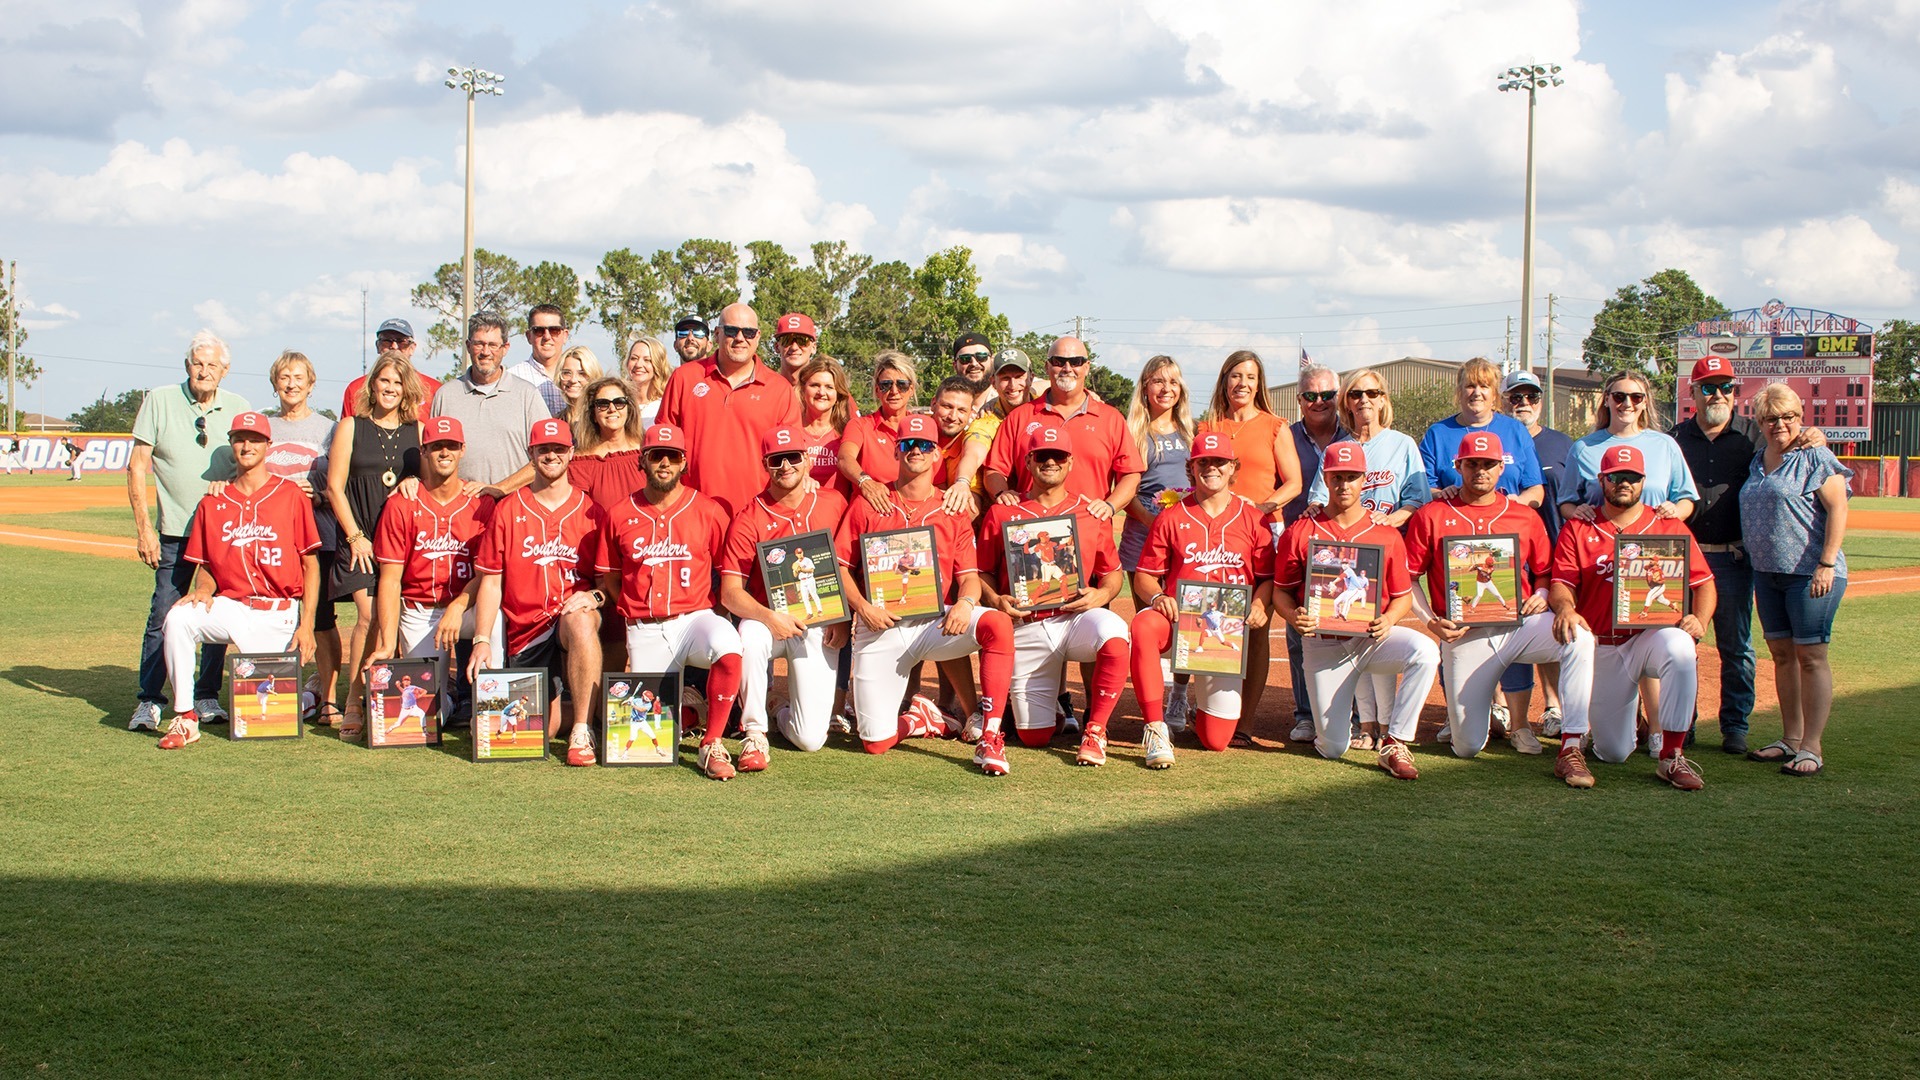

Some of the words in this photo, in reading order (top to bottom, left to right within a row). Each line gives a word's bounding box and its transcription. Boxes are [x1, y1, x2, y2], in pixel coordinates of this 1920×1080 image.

[788, 317, 801, 329] S
[1697, 320, 1755, 334] HISTORIC
[1760, 319, 1810, 333] HENLEY
[1815, 318, 1857, 333] FIELD
[1773, 343, 1803, 351] GEICO
[1818, 336, 1858, 352] GMF
[1707, 358, 1721, 371] S
[1734, 366, 1782, 374] NATIONAL
[1784, 365, 1846, 374] CHAMPIONS
[243, 414, 256, 426] S
[438, 419, 451, 433] S
[910, 418, 923, 431] S
[544, 422, 558, 436] S
[659, 428, 672, 441] S
[1044, 428, 1057, 442] S
[777, 430, 791, 444] S
[1205, 435, 1218, 449] S
[1475, 437, 1488, 452] S
[82, 440, 135, 469] SO
[1338, 447, 1352, 462] S
[1618, 449, 1631, 462] S
[222, 521, 278, 546] Southern
[414, 531, 469, 560] Southern
[522, 536, 579, 566] Southern
[632, 537, 692, 566] Southern
[260, 546, 282, 567] 32
[1184, 542, 1244, 573] Southern
[680, 567, 691, 587] 9
[1622, 590, 1631, 622] SUAREZ
[376, 693, 386, 744] WILLIAMSON
